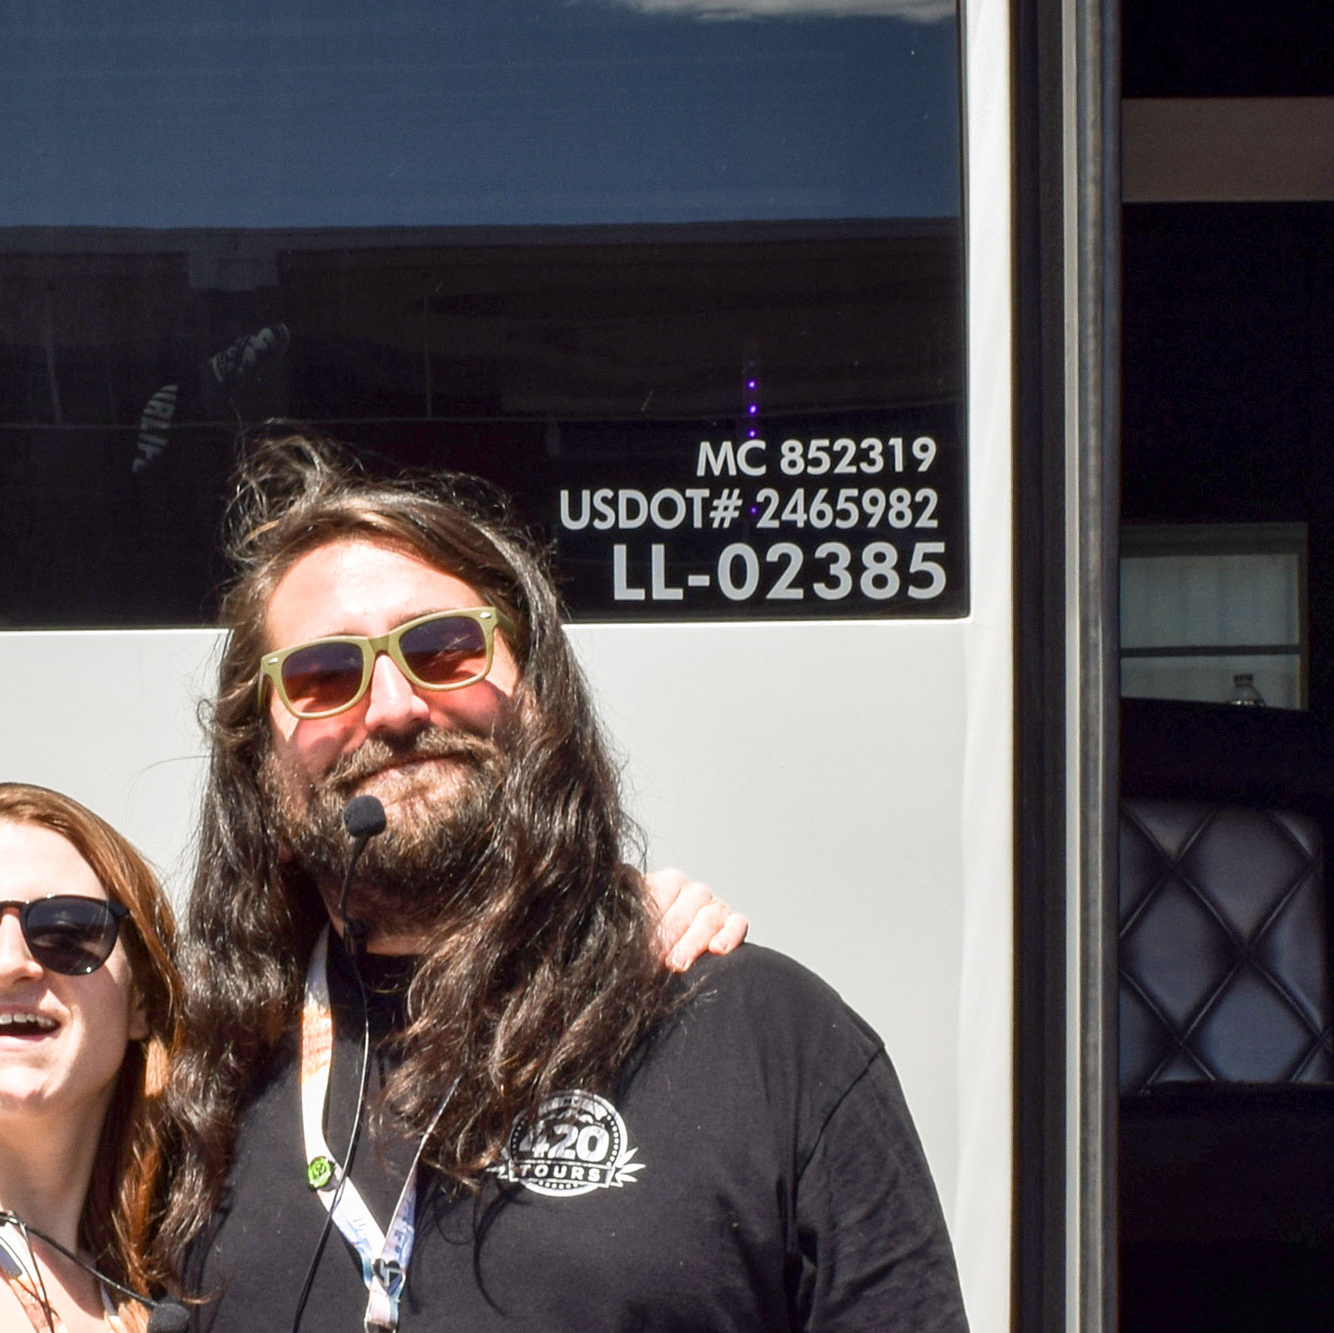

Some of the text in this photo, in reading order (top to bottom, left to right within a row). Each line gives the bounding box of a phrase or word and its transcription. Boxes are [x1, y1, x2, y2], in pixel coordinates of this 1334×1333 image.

[696, 437, 937, 477] MC 852319
[559, 488, 939, 530] USDOT# 2465982
[613, 542, 947, 600] LL-02385
[518, 1121, 610, 1162] 420
[520, 1164, 601, 1182] TOURS
